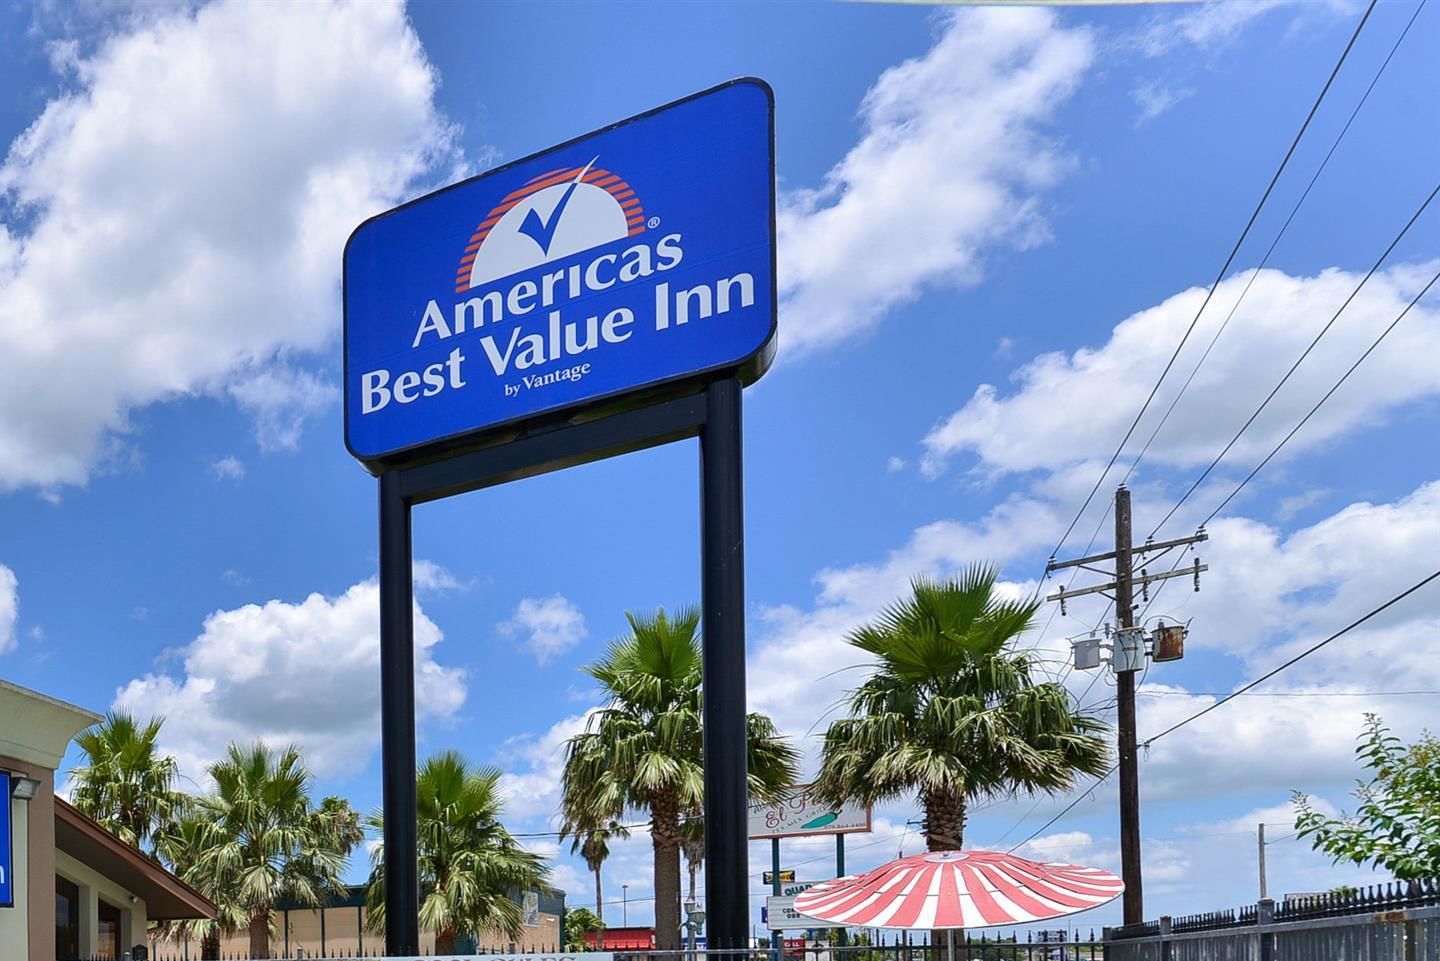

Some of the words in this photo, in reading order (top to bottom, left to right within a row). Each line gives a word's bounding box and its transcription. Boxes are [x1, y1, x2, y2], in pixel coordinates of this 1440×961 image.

[361, 346, 466, 415] Best
[480, 306, 634, 376] Value
[655, 272, 755, 331] Inn
[412, 232, 683, 348] Americas
[504, 373, 521, 397] by
[522, 362, 591, 390] Vantage
